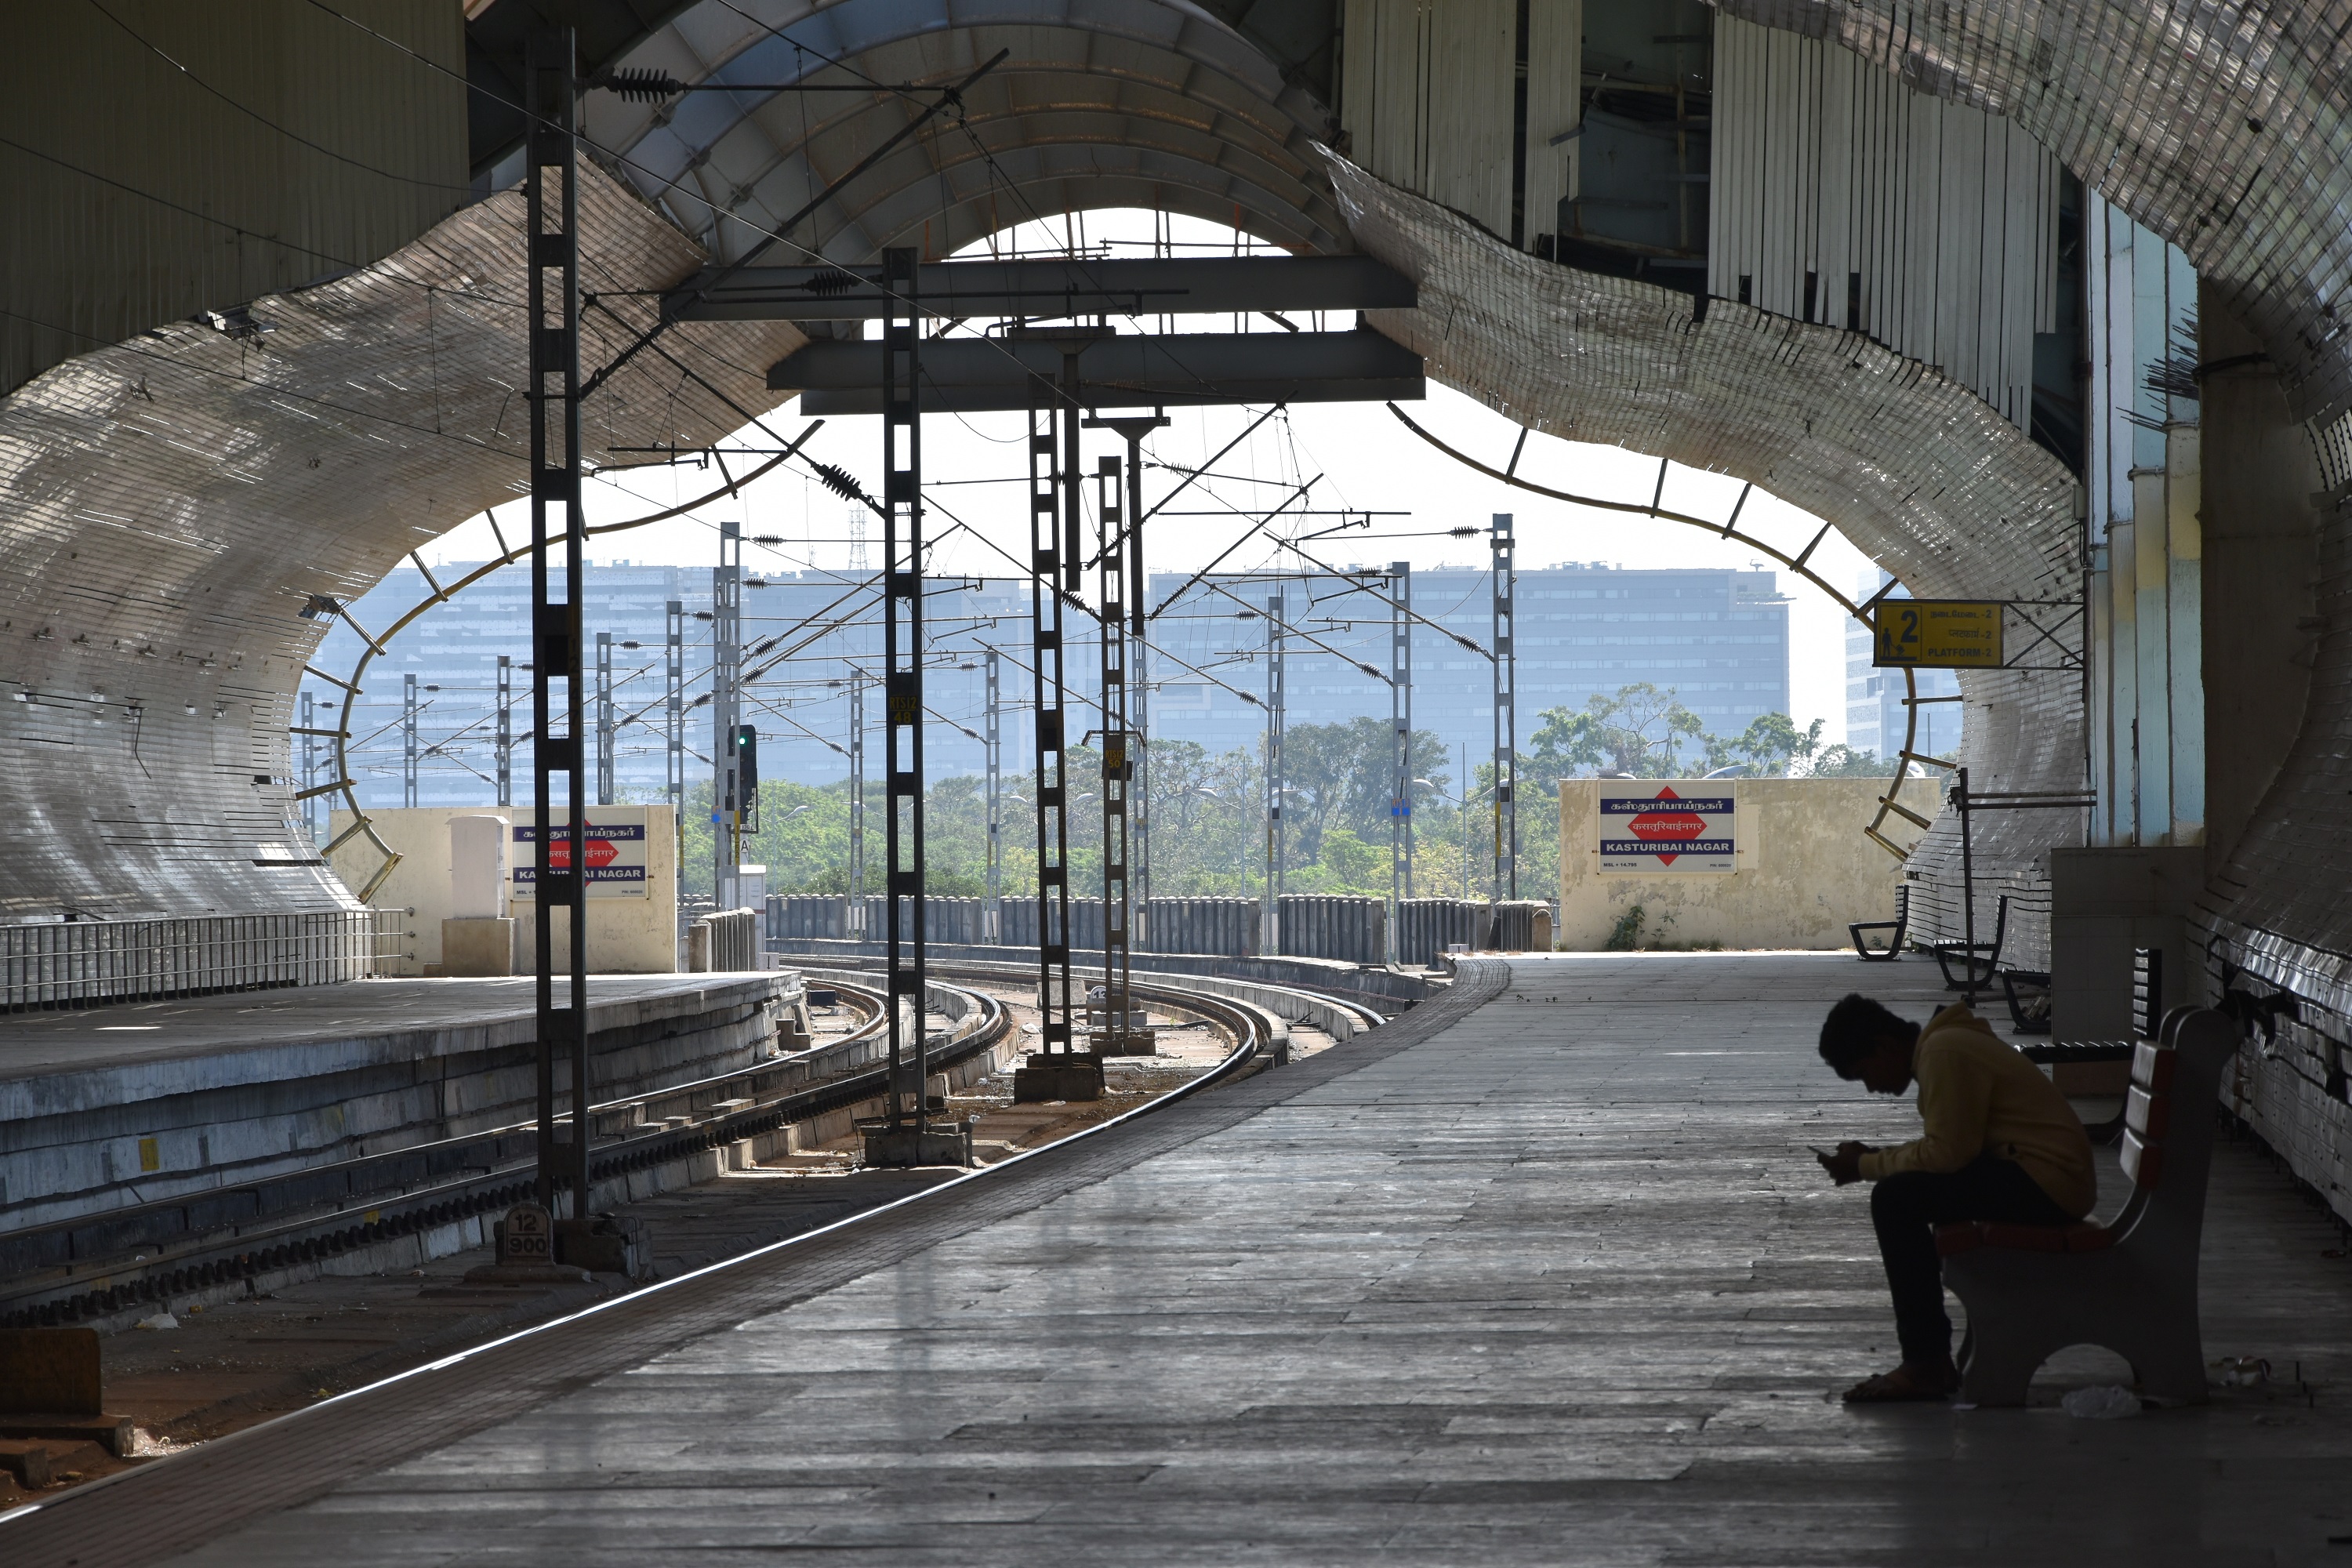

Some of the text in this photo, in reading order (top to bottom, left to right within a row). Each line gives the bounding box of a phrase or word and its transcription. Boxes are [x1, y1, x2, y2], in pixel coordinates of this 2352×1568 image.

[1900, 610, 1918, 643] 2
[894, 711, 912, 724] 48
[1108, 760, 1121, 768] 50
[741, 840, 749, 851] A
[598, 869, 641, 878] NAGAR
[516, 1214, 536, 1231] 12
[510, 1238, 546, 1253] 900
